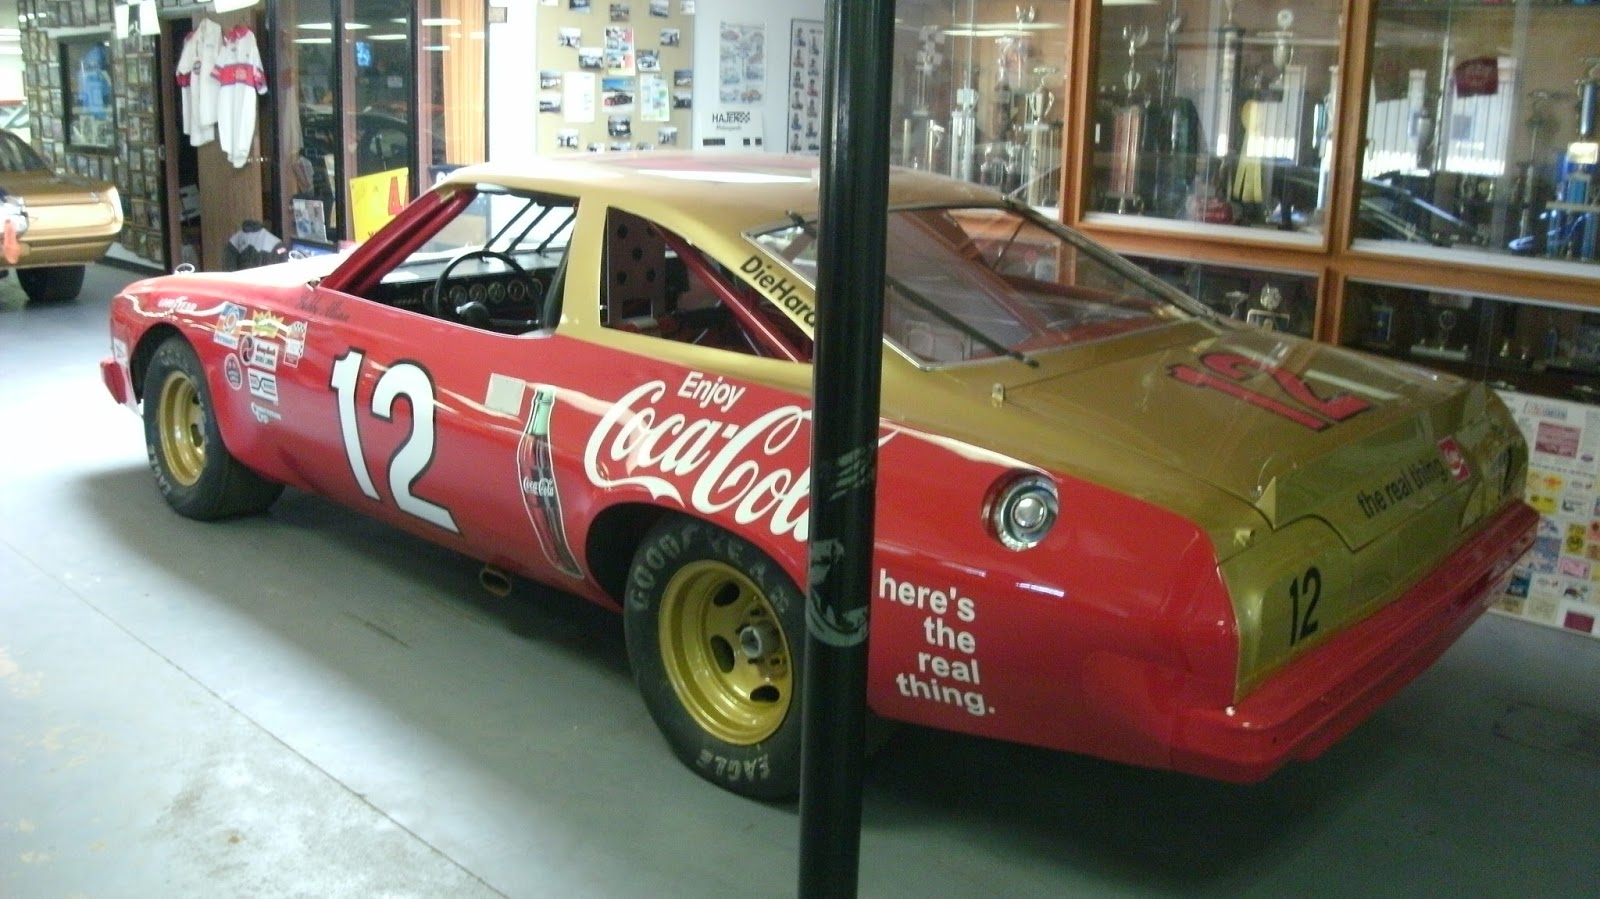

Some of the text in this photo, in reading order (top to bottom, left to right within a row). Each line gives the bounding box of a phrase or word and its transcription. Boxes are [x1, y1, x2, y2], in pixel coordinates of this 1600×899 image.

[677, 370, 746, 413] Enjoy
[1167, 352, 1373, 432] 12
[329, 345, 463, 537] 12
[584, 380, 812, 542] Coca-Col
[1356, 489, 1387, 519] the
[1385, 474, 1413, 506] real
[1408, 457, 1449, 488] thing
[879, 568, 976, 622] here's
[1289, 567, 1321, 647] 12
[923, 615, 976, 655] the
[896, 672, 996, 717] thing.
[918, 651, 980, 686] real
[696, 749, 771, 781] EAGLE
